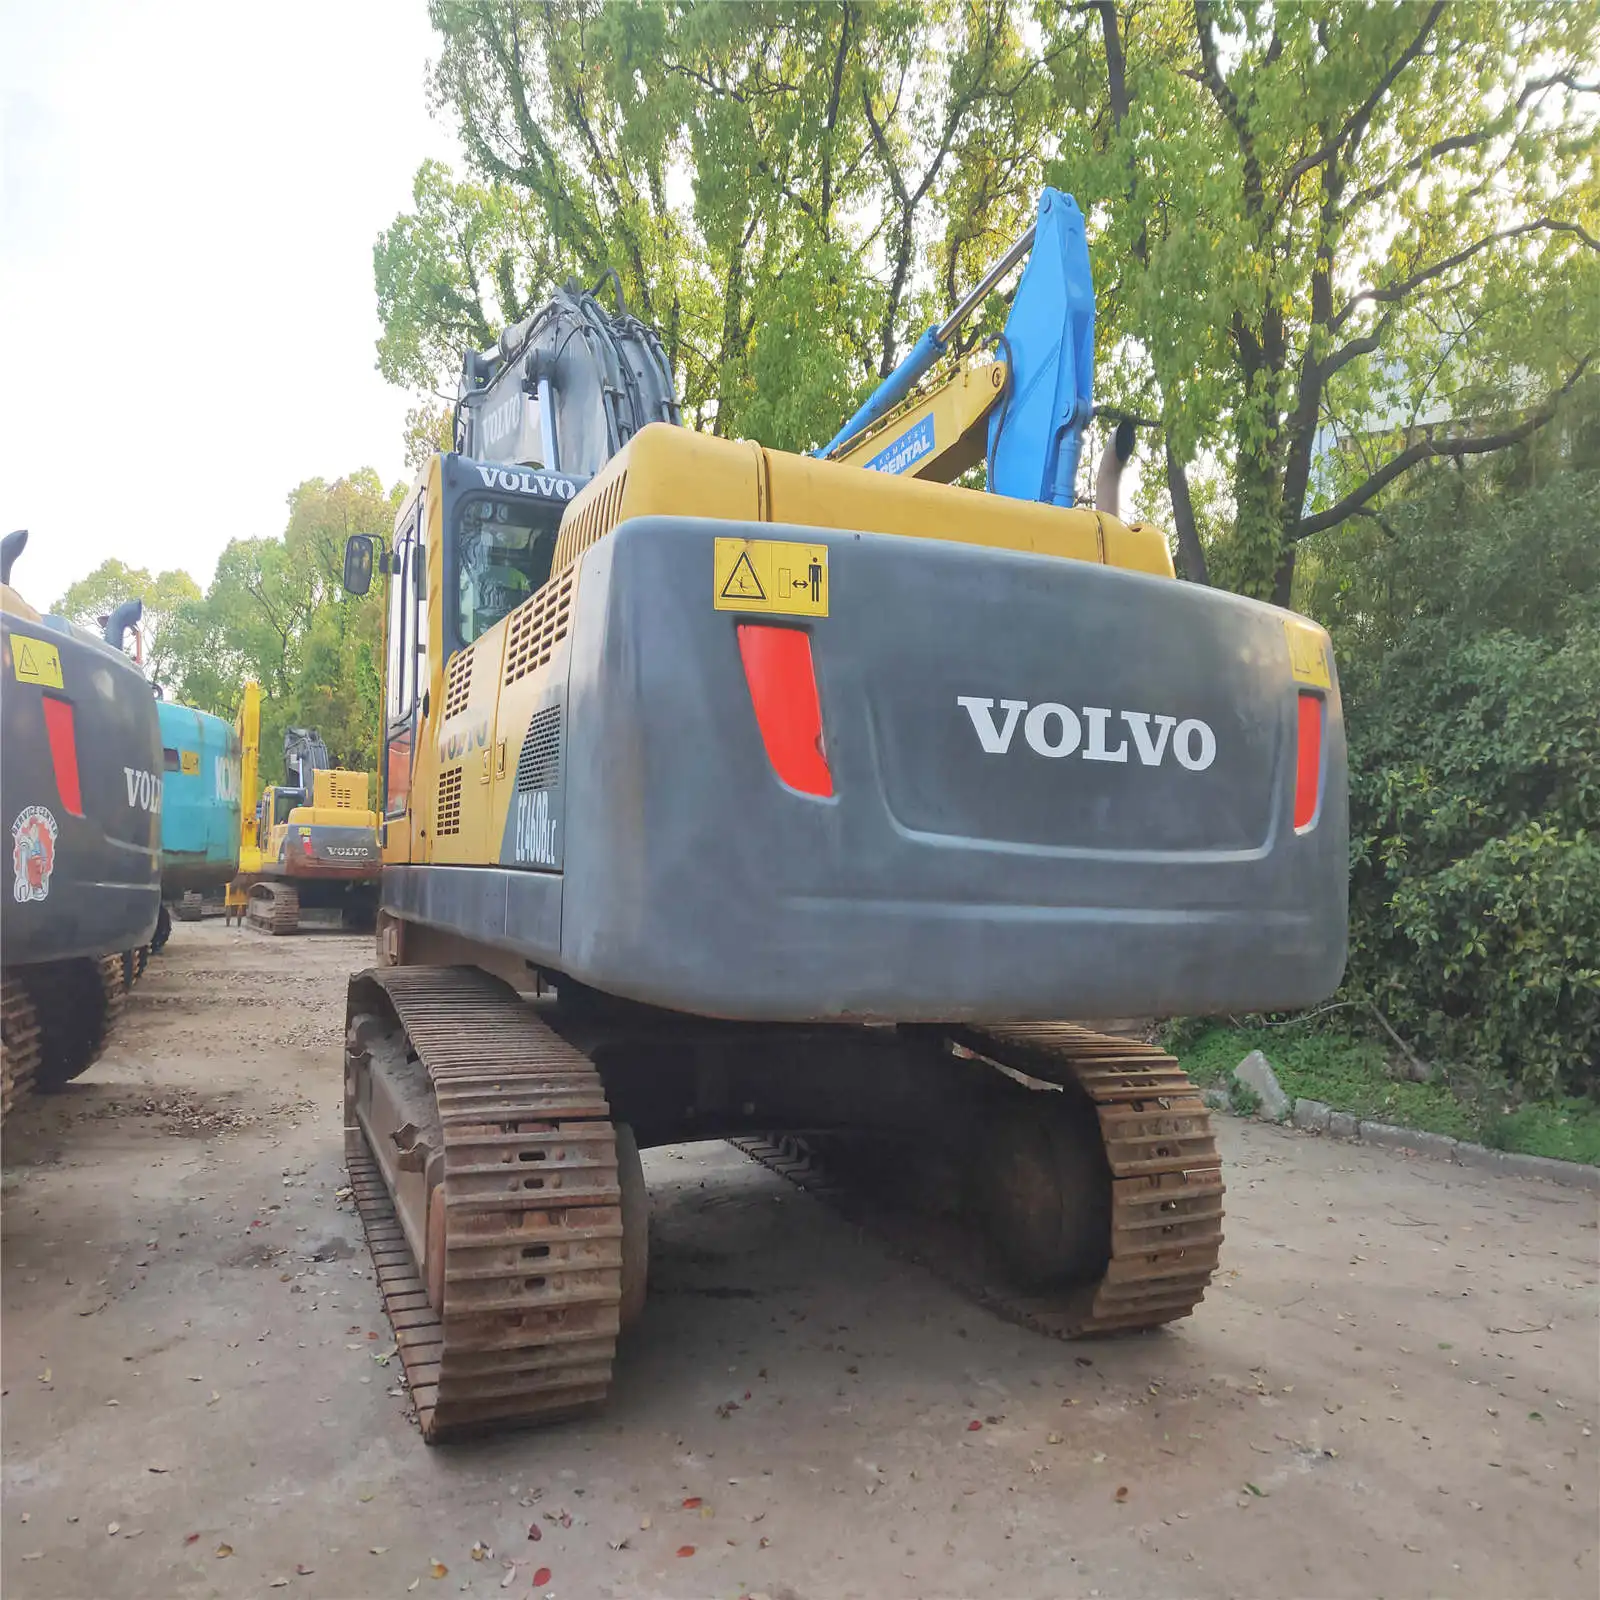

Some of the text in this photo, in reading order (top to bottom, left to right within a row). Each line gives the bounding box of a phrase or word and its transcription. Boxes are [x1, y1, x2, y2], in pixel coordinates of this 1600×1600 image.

[481, 391, 521, 450] VOLVO
[476, 466, 576, 500] VOLVO
[957, 696, 1216, 771] VOLVO
[326, 846, 368, 856] VOLVO
